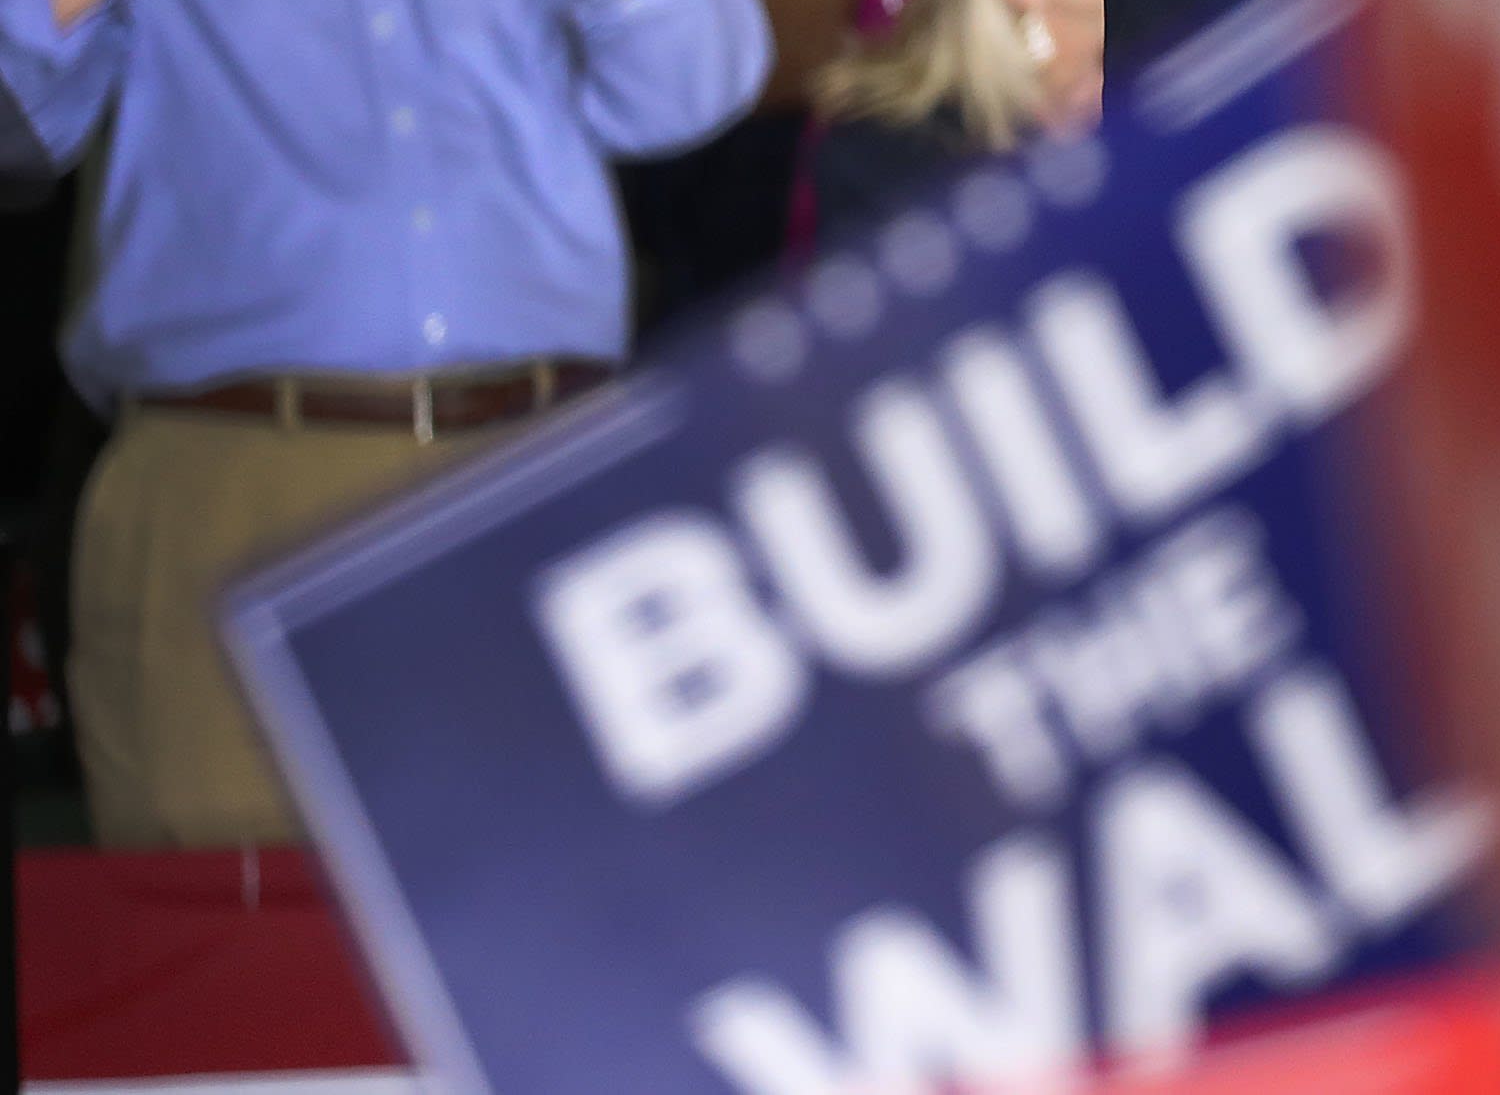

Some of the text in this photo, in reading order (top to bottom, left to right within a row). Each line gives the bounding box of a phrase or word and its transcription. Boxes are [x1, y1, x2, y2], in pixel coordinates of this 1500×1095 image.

[535, 125, 1414, 808] BUILD
[930, 505, 1302, 808] THE
[690, 657, 1500, 1095] WAL
